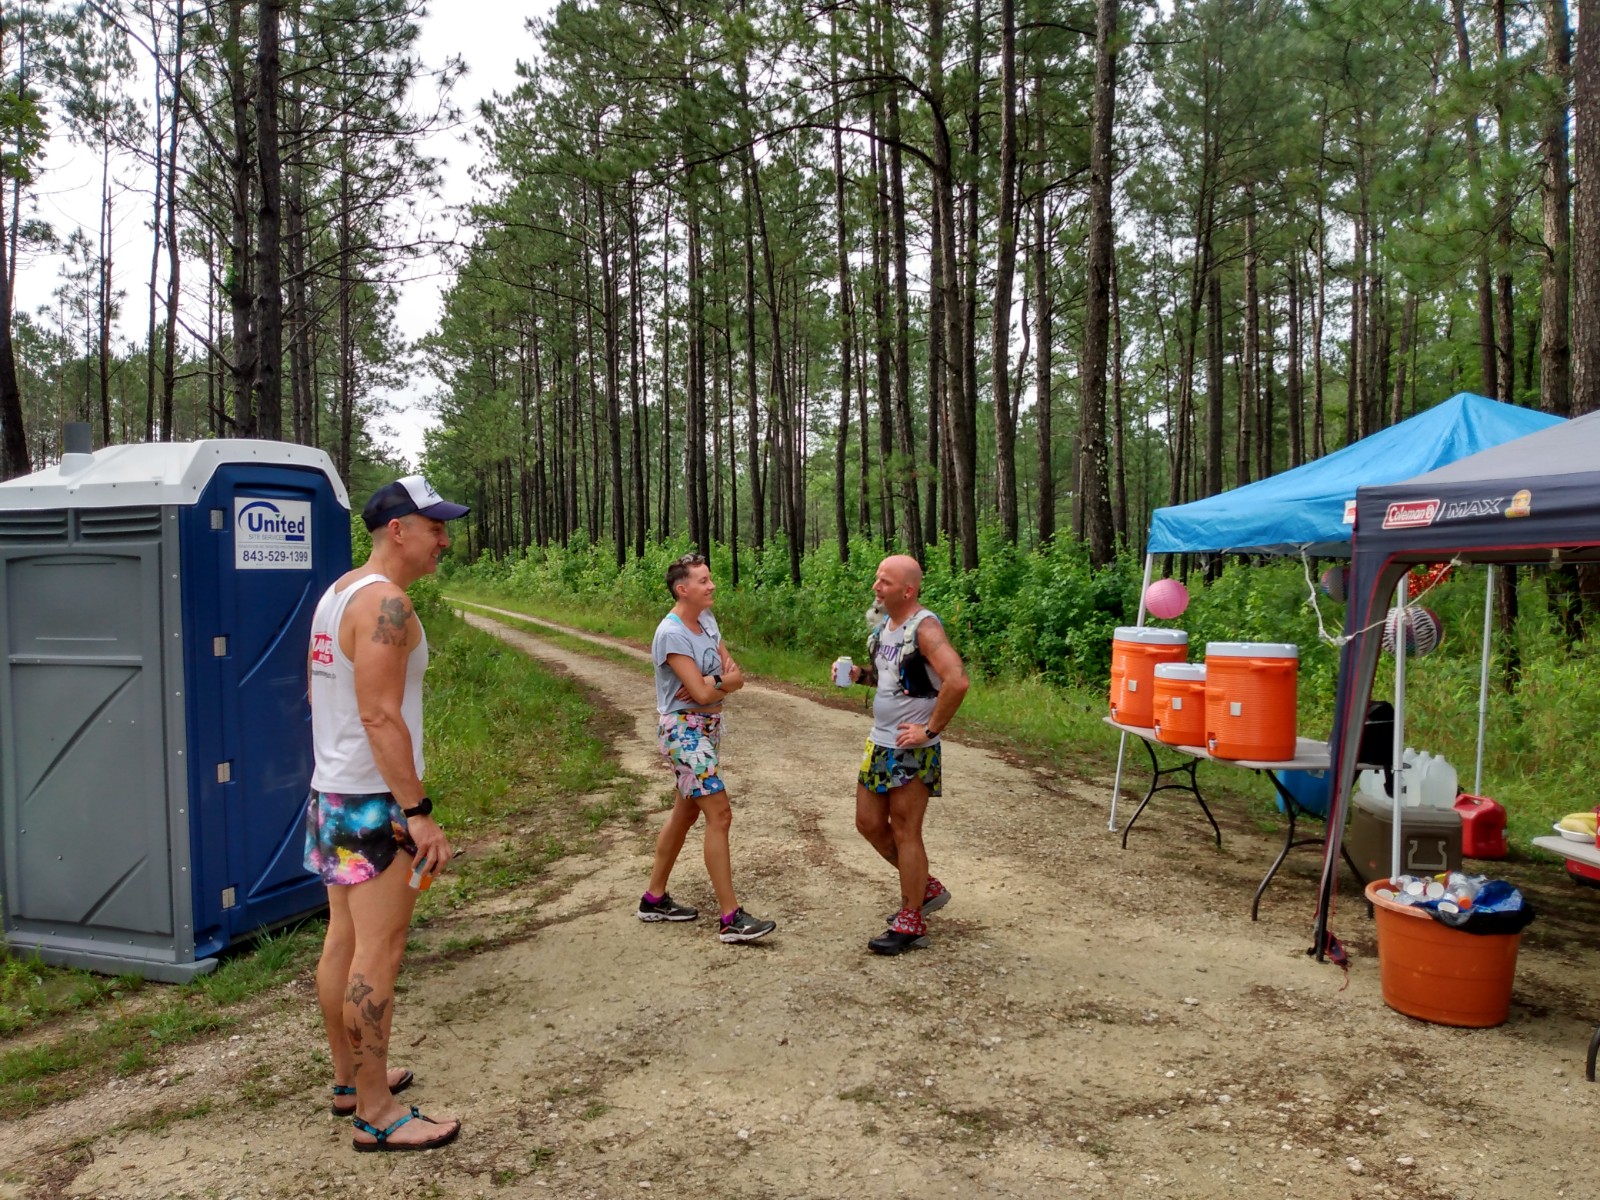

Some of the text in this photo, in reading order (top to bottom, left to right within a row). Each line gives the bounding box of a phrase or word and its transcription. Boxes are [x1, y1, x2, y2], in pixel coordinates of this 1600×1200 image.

[1389, 504, 1426, 522] Coleman
[1446, 497, 1505, 519] MAX
[247, 512, 306, 534] United
[243, 550, 309, 562] 843-529-1399
